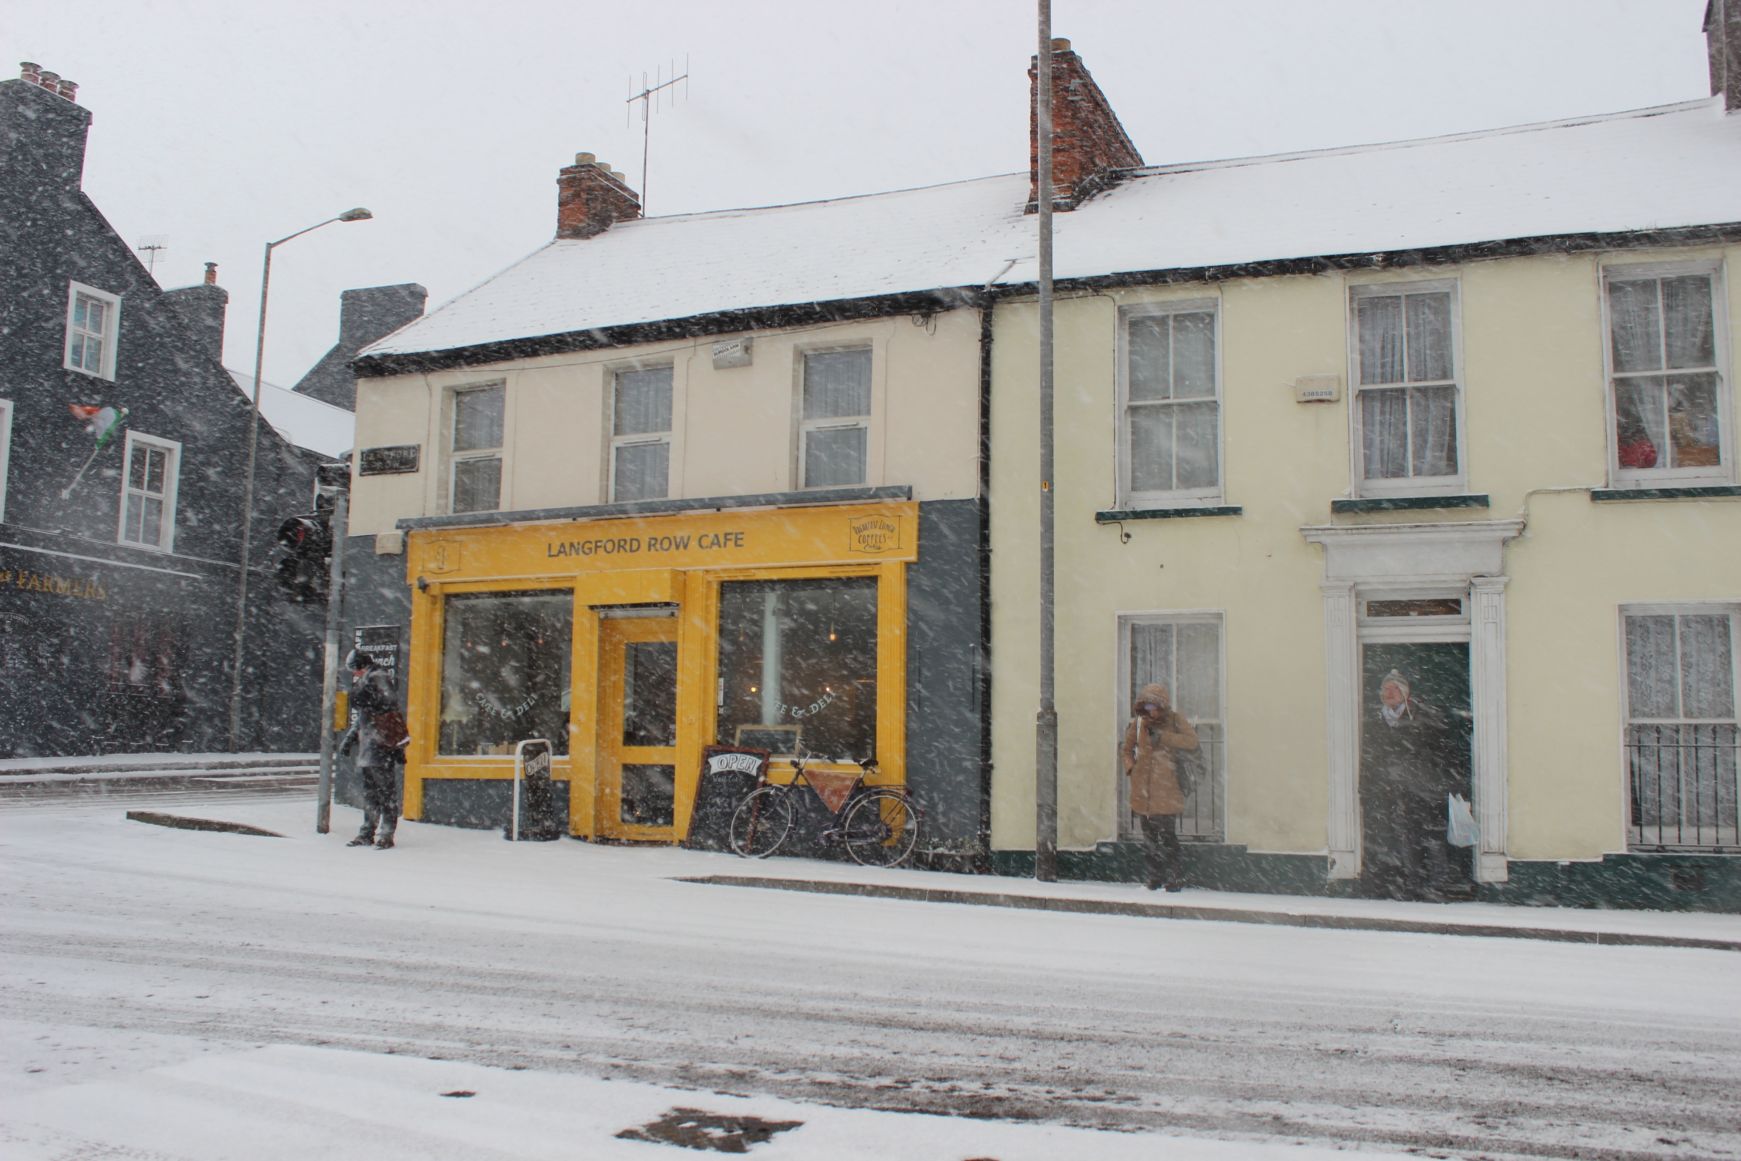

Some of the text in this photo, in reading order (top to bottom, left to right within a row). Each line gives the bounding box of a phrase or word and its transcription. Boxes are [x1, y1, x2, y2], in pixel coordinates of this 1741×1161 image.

[547, 531, 745, 558] LANGFORD ROW CAFE
[717, 755, 757, 772] OPEN
